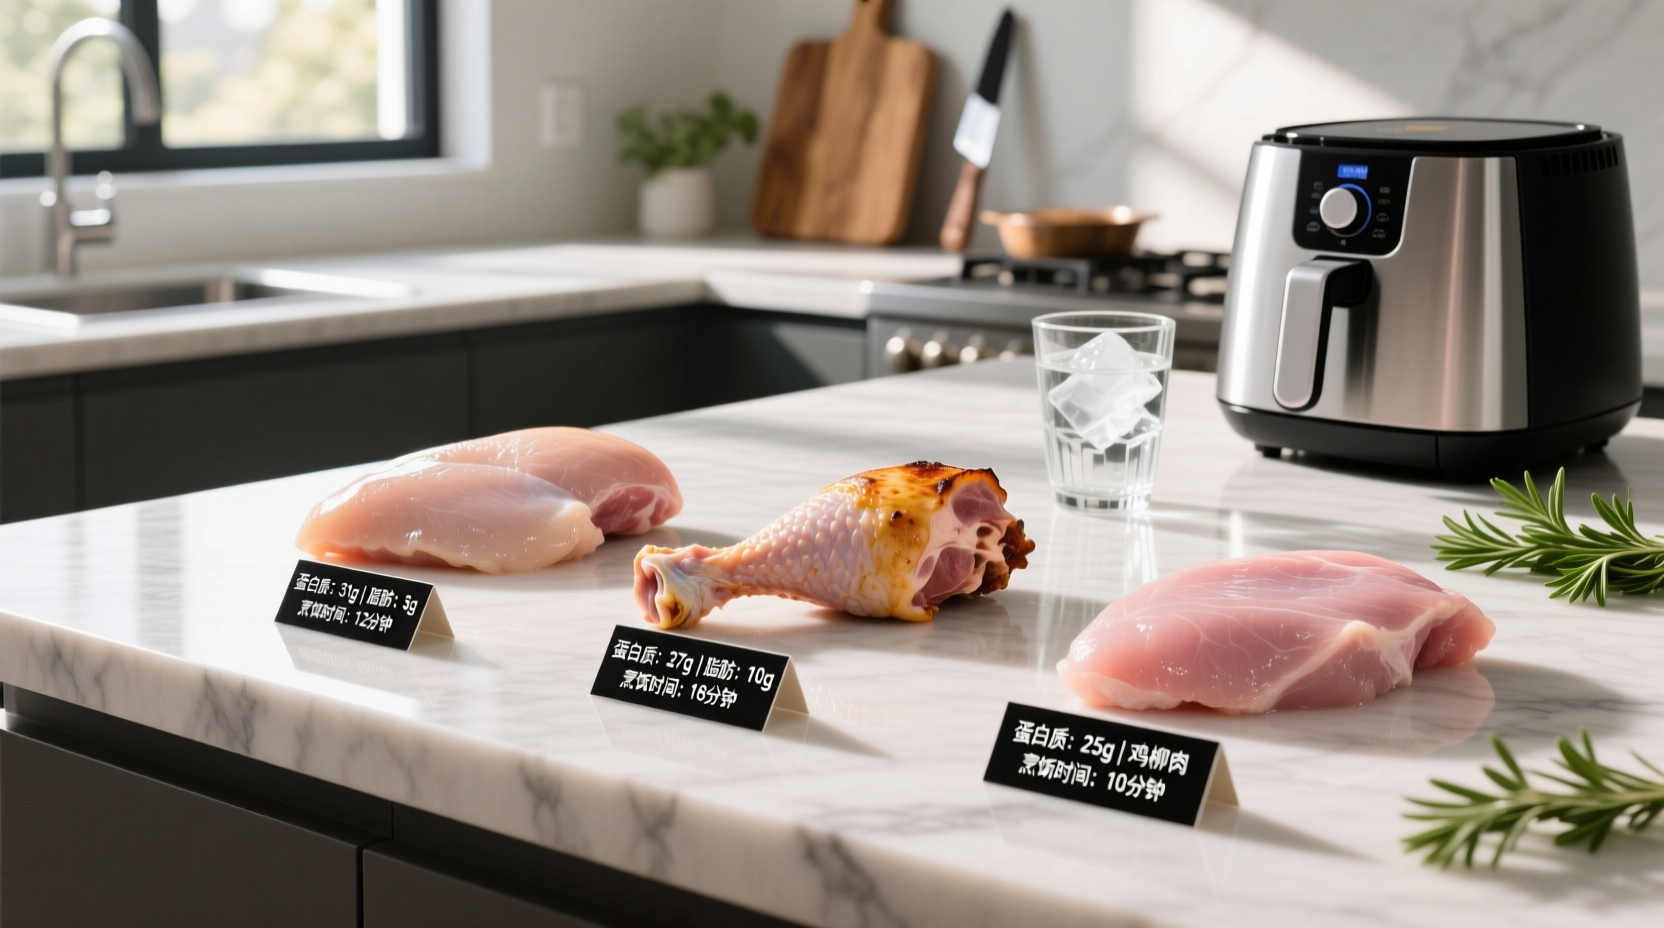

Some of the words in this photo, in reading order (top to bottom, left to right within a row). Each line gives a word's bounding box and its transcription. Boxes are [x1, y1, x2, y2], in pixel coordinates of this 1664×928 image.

[338, 582, 360, 604] 31g
[666, 650, 694, 676] 27g
[747, 665, 775, 692] 10g
[1080, 734, 1115, 764] 25g
